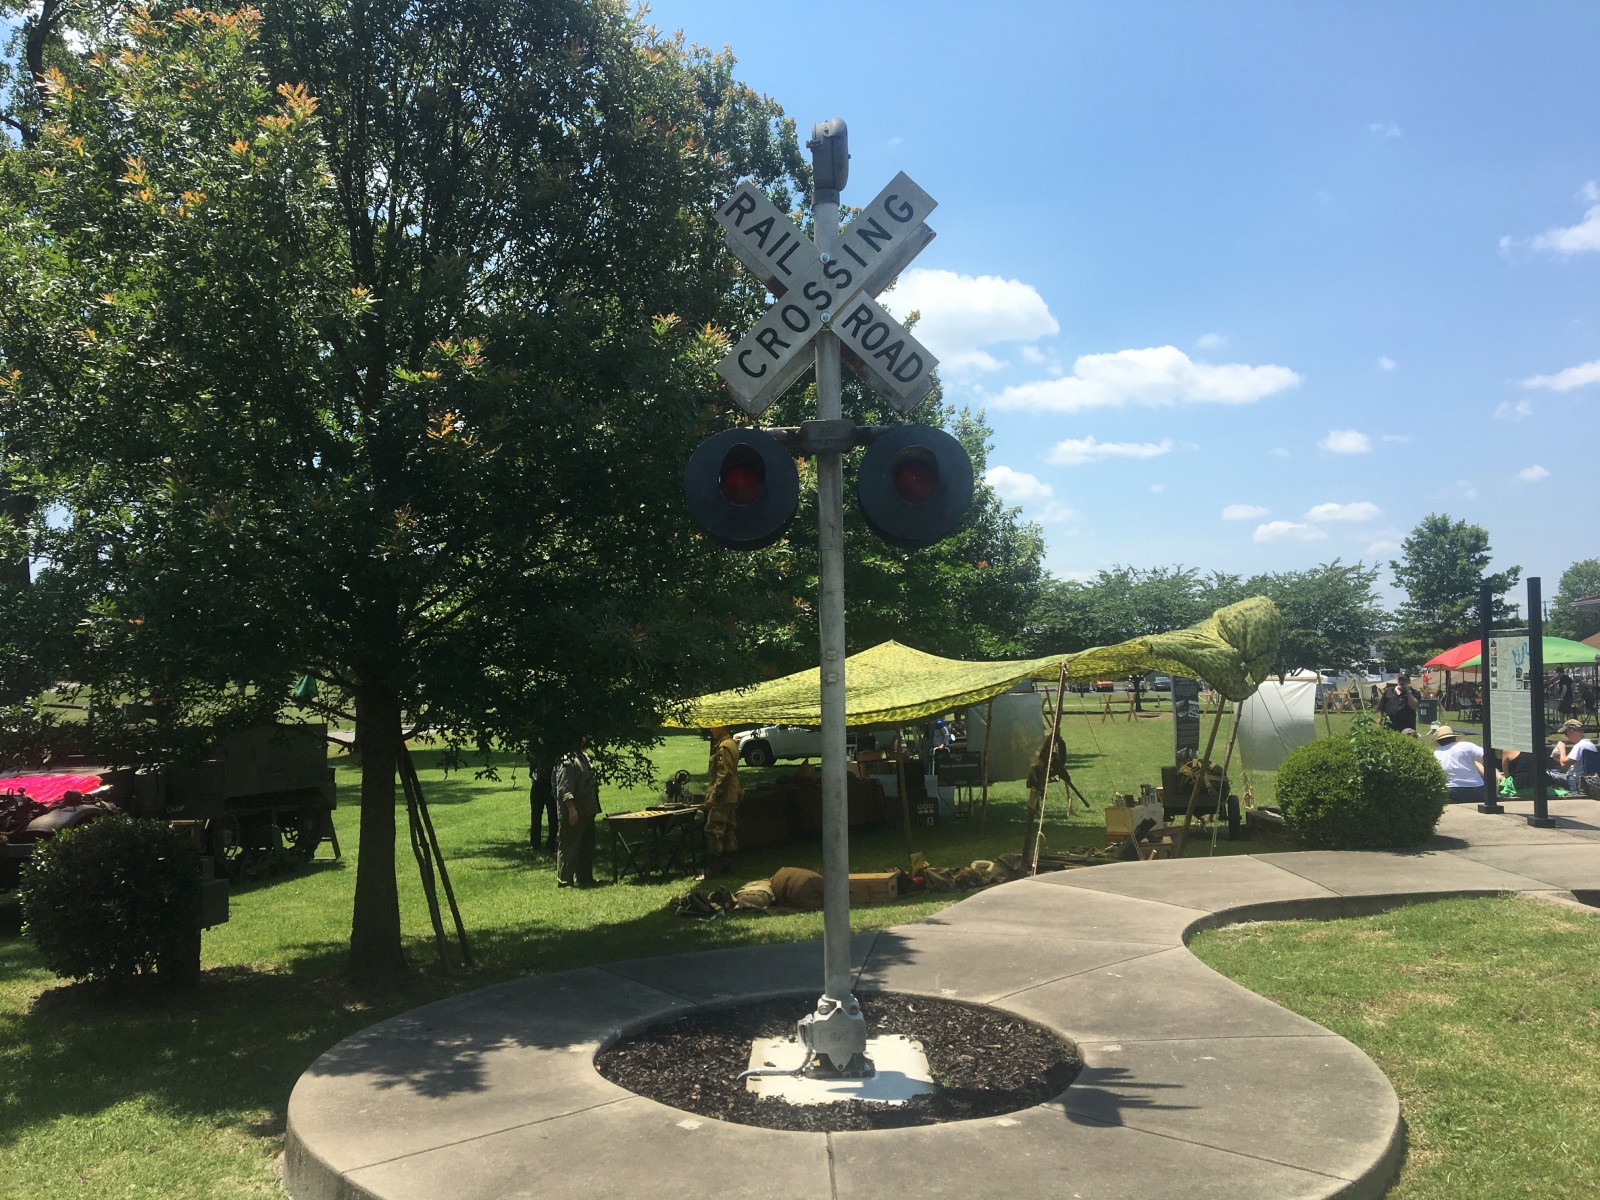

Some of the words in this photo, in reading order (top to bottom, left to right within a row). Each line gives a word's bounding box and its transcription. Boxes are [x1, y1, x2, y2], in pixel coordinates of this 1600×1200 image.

[724, 191, 801, 276] RAIL
[841, 303, 924, 383] ROAD
[737, 194, 914, 378] CROSSING
